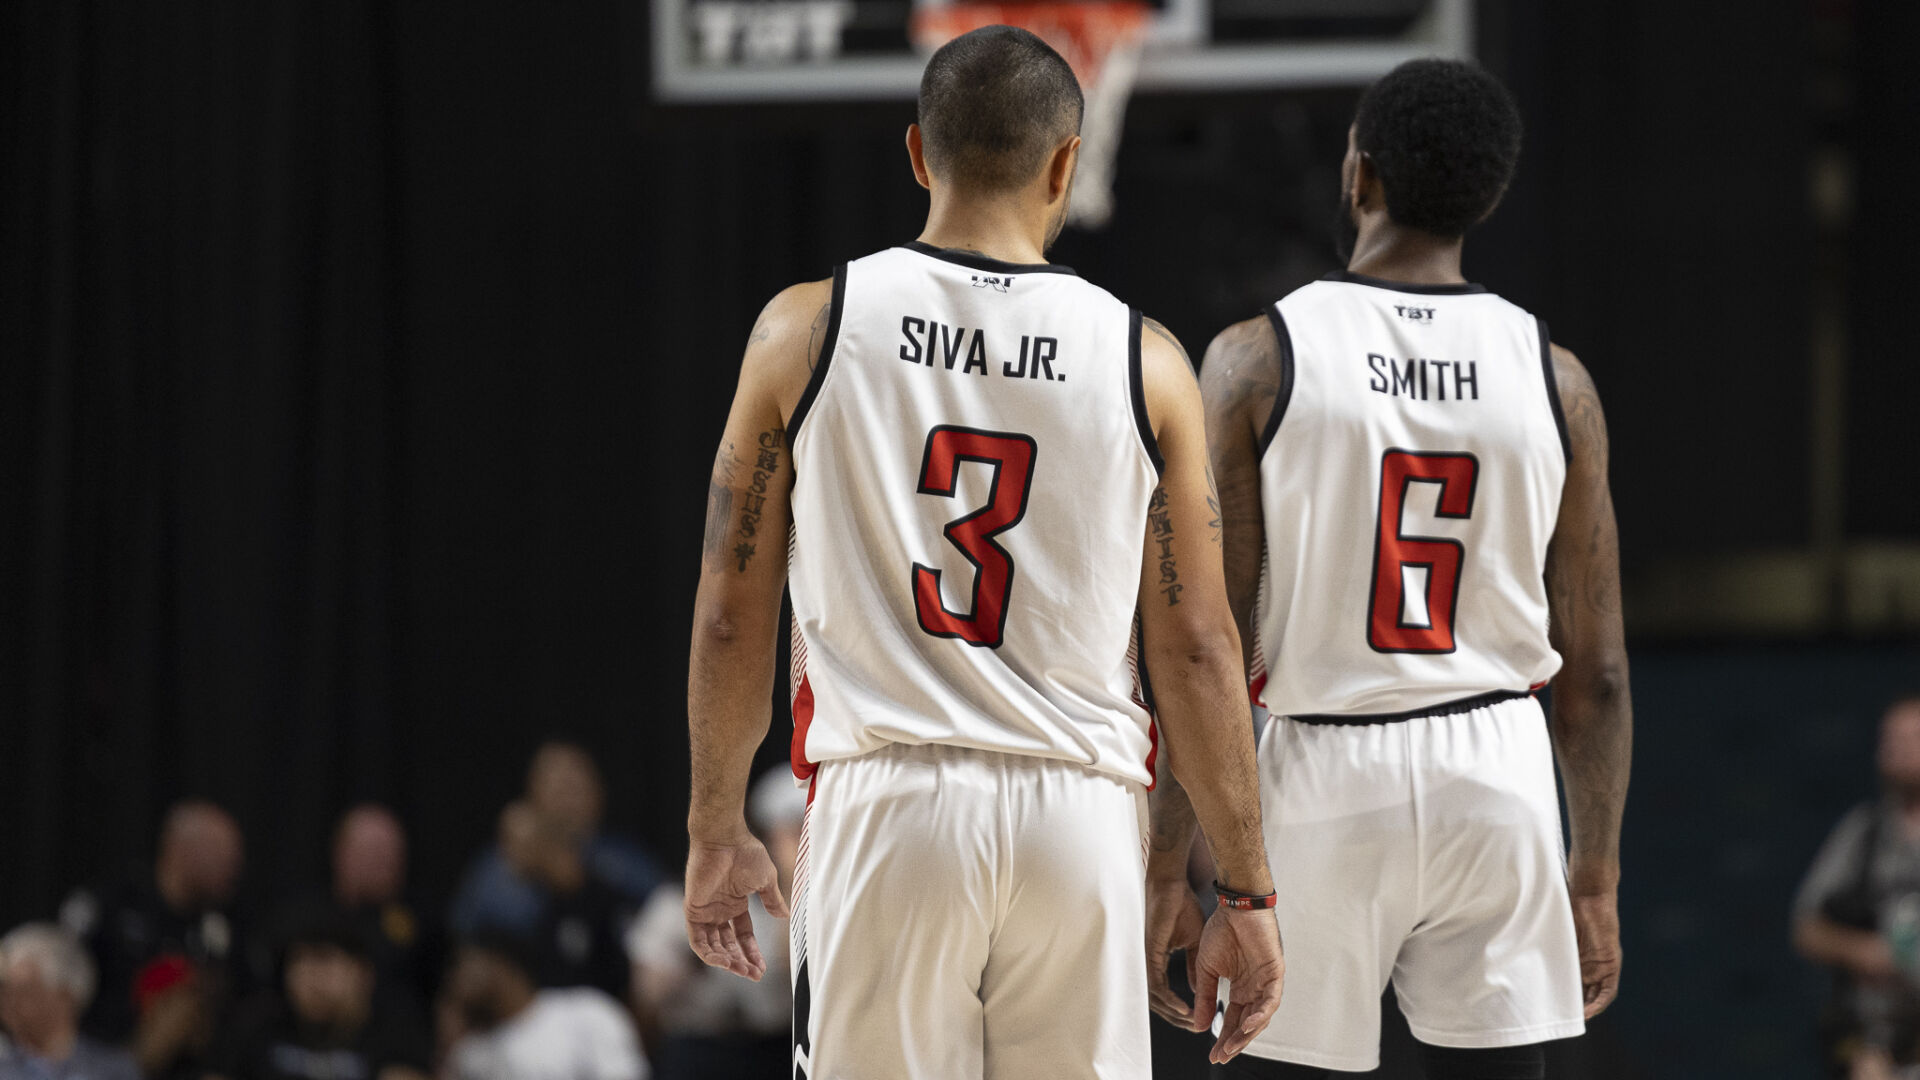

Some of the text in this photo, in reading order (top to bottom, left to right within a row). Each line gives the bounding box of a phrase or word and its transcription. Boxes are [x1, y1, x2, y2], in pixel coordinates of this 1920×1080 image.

[900, 315, 1066, 382] SIVA JR.
[1367, 352, 1478, 401] SMITH
[912, 424, 1038, 650] 3
[1367, 446, 1480, 655] 6
